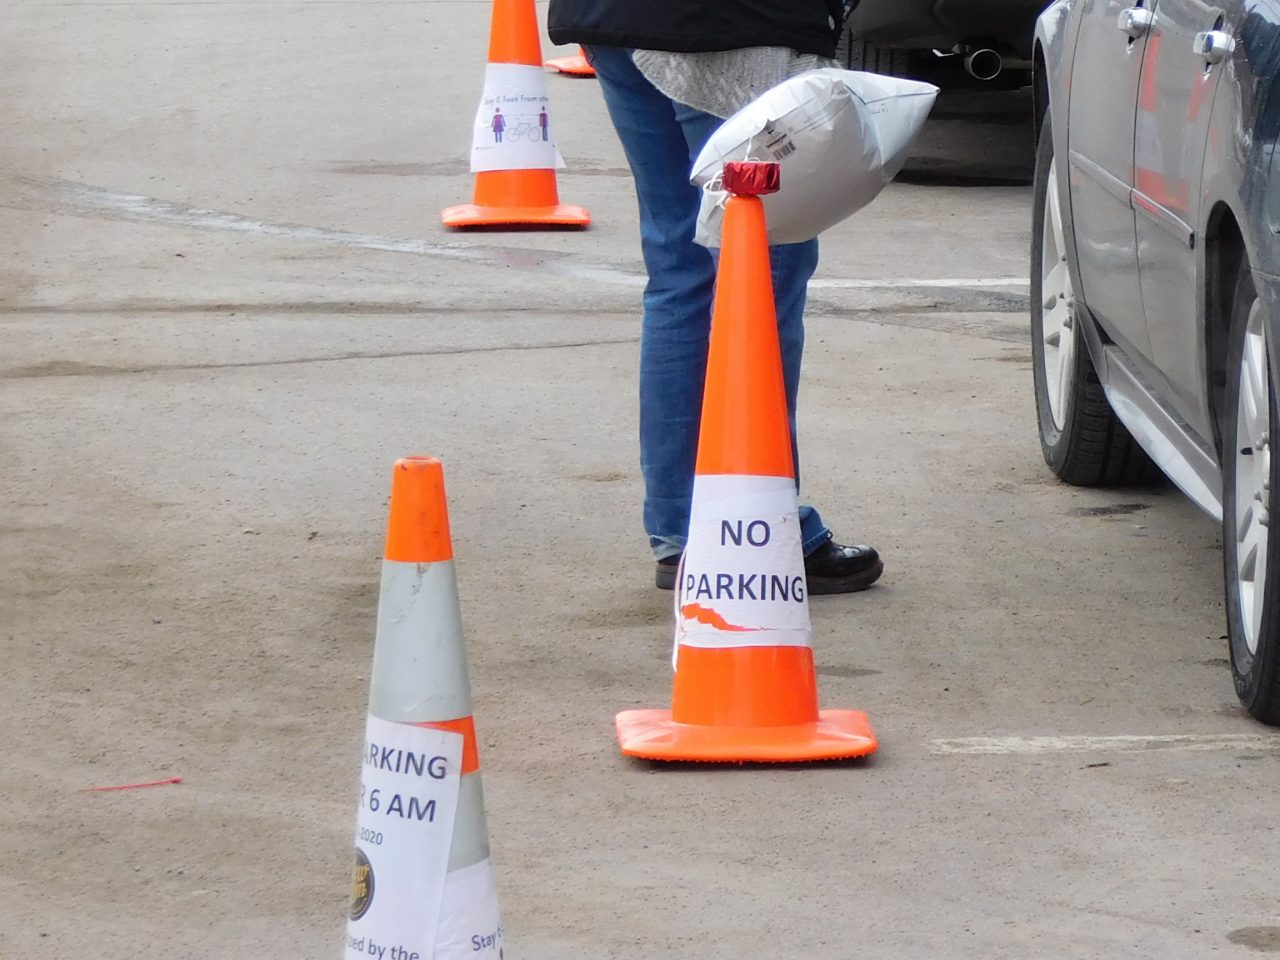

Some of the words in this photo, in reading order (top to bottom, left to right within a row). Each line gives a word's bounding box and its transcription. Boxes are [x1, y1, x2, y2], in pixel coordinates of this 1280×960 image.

[721, 520, 771, 547] NO
[686, 573, 804, 603] PARKING
[369, 788, 381, 812] 6
[386, 793, 437, 823] AM
[368, 938, 387, 960] by
[390, 945, 420, 960] the
[471, 931, 497, 952] Stay
